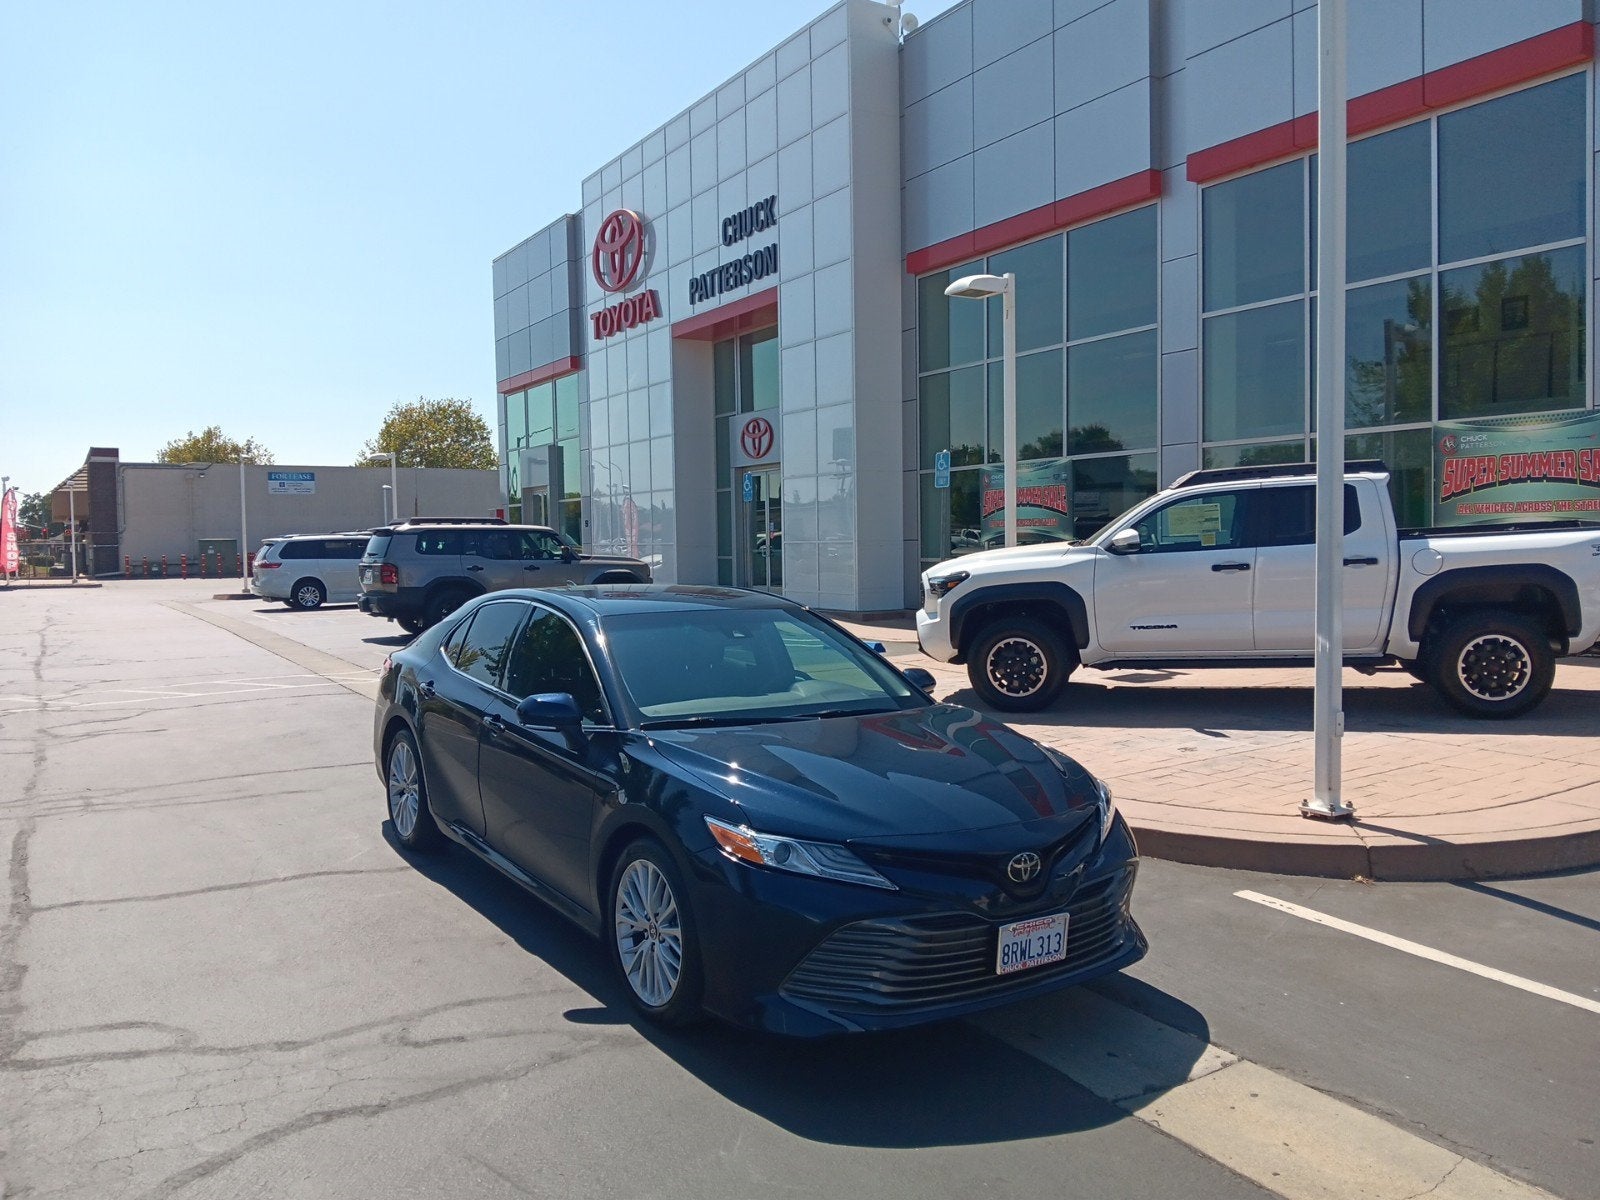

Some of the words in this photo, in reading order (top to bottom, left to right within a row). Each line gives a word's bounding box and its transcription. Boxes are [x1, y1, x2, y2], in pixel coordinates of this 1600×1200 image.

[722, 195, 777, 247] CHUCK
[689, 243, 778, 305] PATTERSON
[590, 289, 660, 340] TOYOTA
[1460, 434, 1488, 443] CHUCK
[1460, 440, 1506, 450] PATTERSON
[1442, 455, 1498, 499] SUPER
[1499, 450, 1577, 482] SUMMER
[1043, 484, 1068, 513] SALE
[1458, 503, 1473, 514] ALL
[1474, 502, 1514, 513] VEHICLES
[1515, 501, 1553, 513] ACROSS
[1555, 500, 1573, 512] THE
[6, 532, 18, 570] SHOP
[1001, 963, 1023, 973] CHUCK
[1026, 953, 1063, 968] PATTERSON
[1002, 932, 1062, 966] 8RWL313
